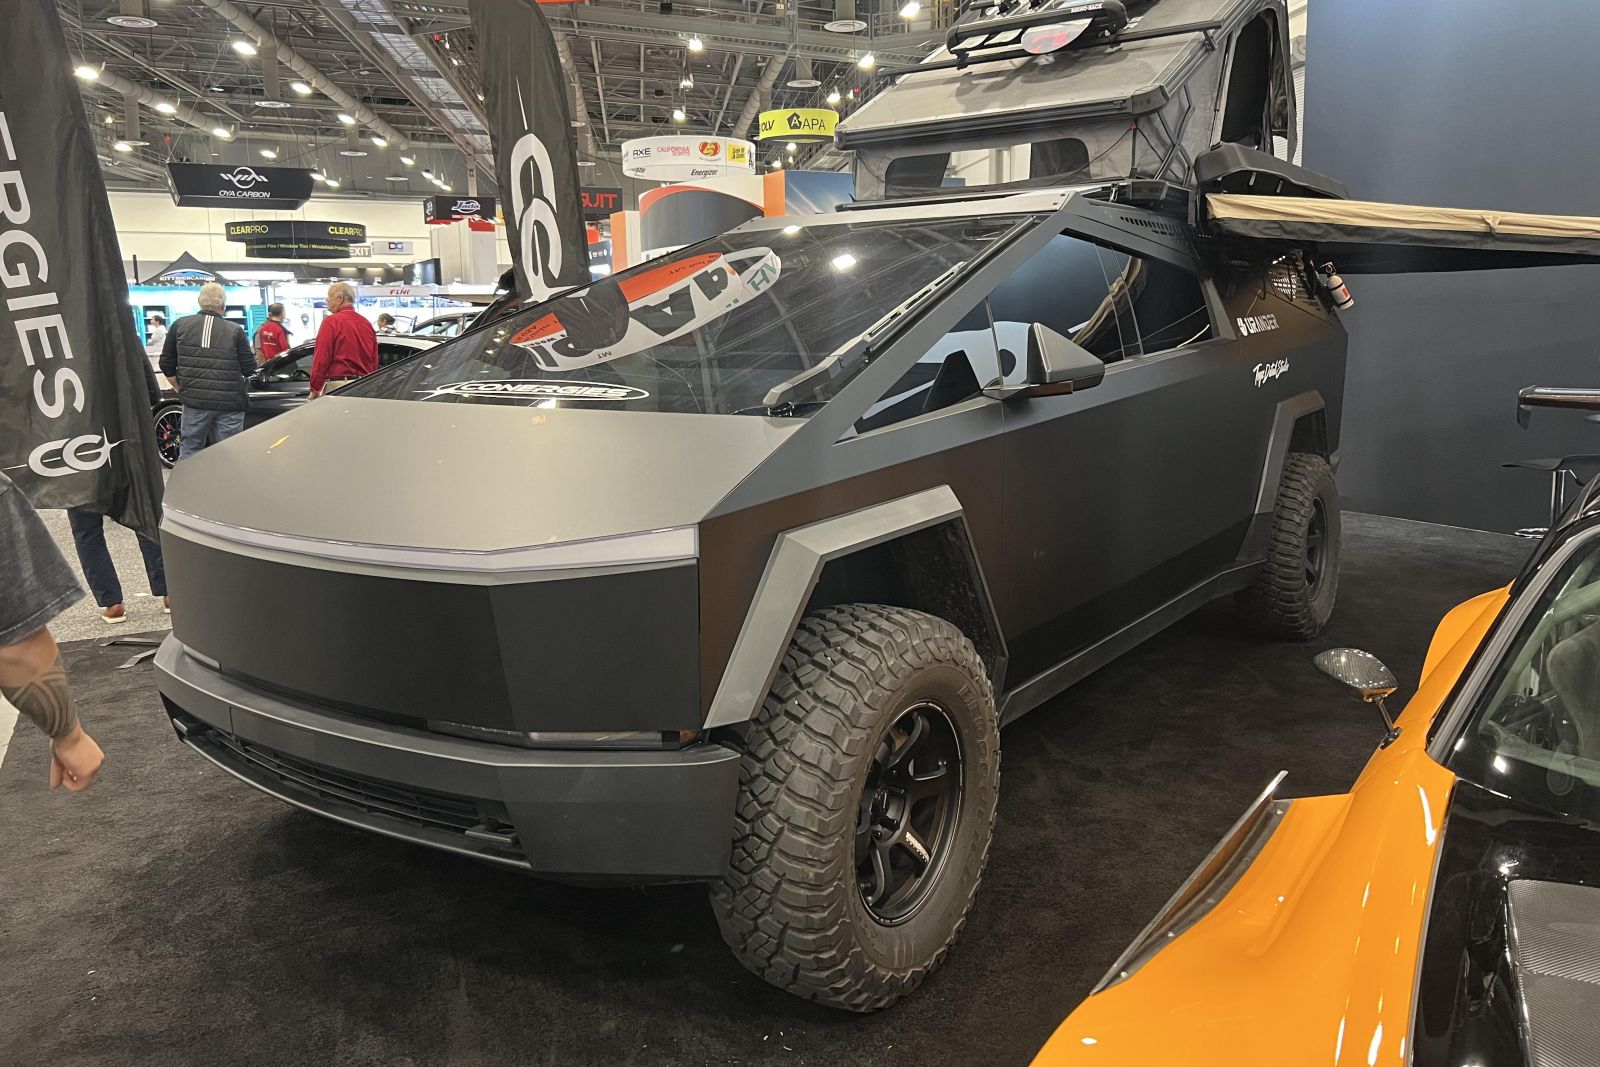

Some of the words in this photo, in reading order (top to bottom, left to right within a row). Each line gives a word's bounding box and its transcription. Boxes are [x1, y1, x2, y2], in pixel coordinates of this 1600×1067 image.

[802, 118, 826, 131] APA
[690, 168, 719, 178] Energizer
[236, 190, 271, 198] CARBON
[230, 225, 268, 235] CLEARPRO
[328, 226, 363, 236] CLEARPRO
[350, 247, 370, 256] EXIT
[460, 384, 633, 398] CONERGIES
